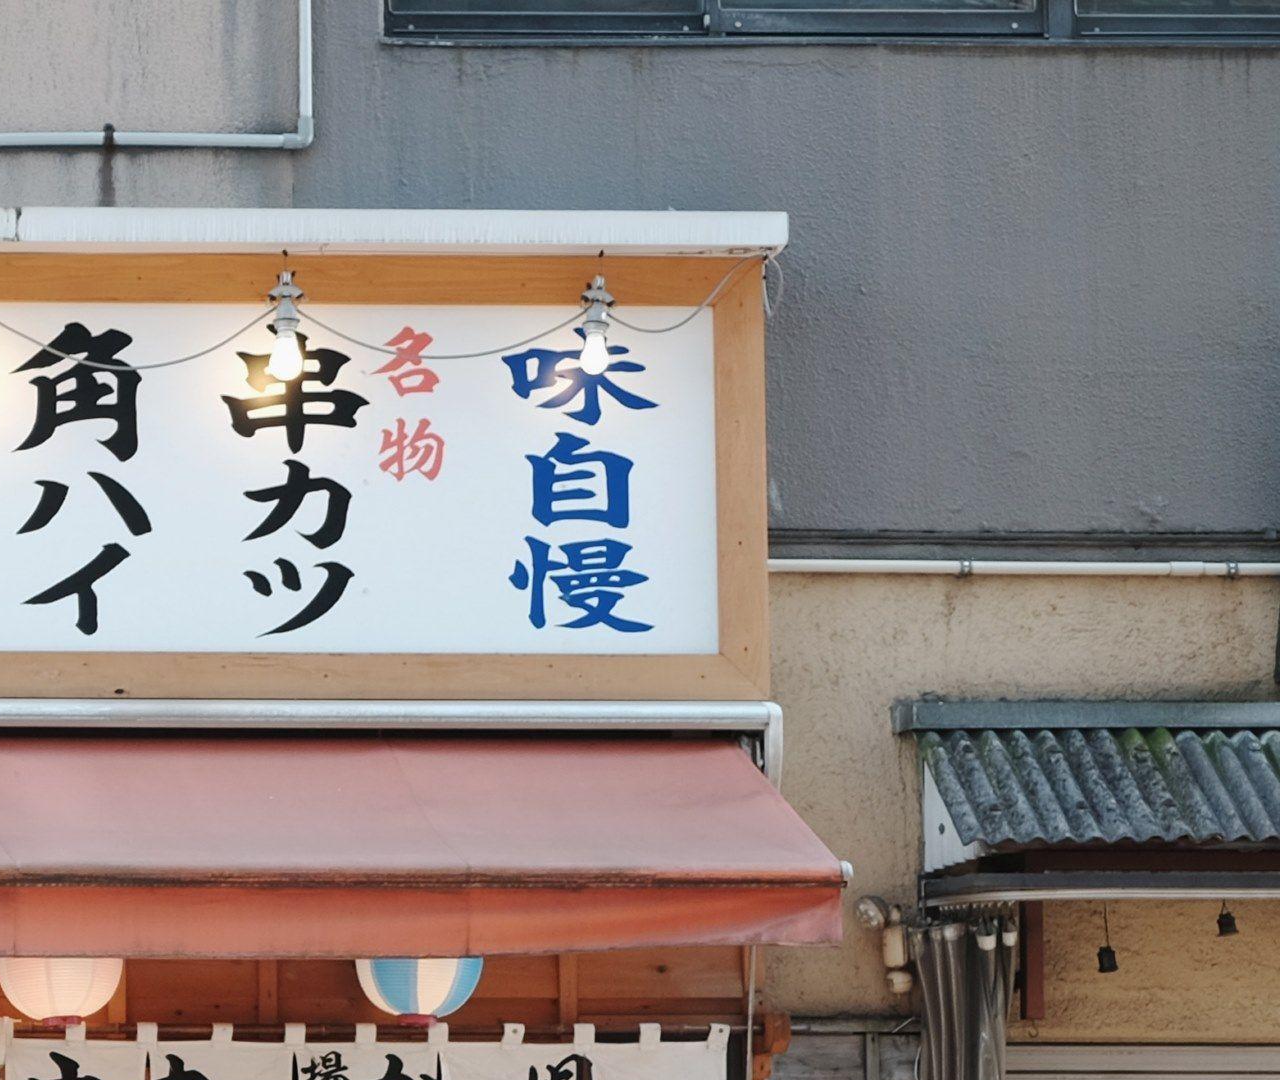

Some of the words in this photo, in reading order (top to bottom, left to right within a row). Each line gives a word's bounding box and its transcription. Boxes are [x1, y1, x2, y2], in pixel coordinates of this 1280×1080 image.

[11, 321, 153, 636] 角ハイ
[220, 322, 371, 638] 串カツ
[373, 325, 445, 482] 名物
[500, 326, 660, 634] 味自慢
